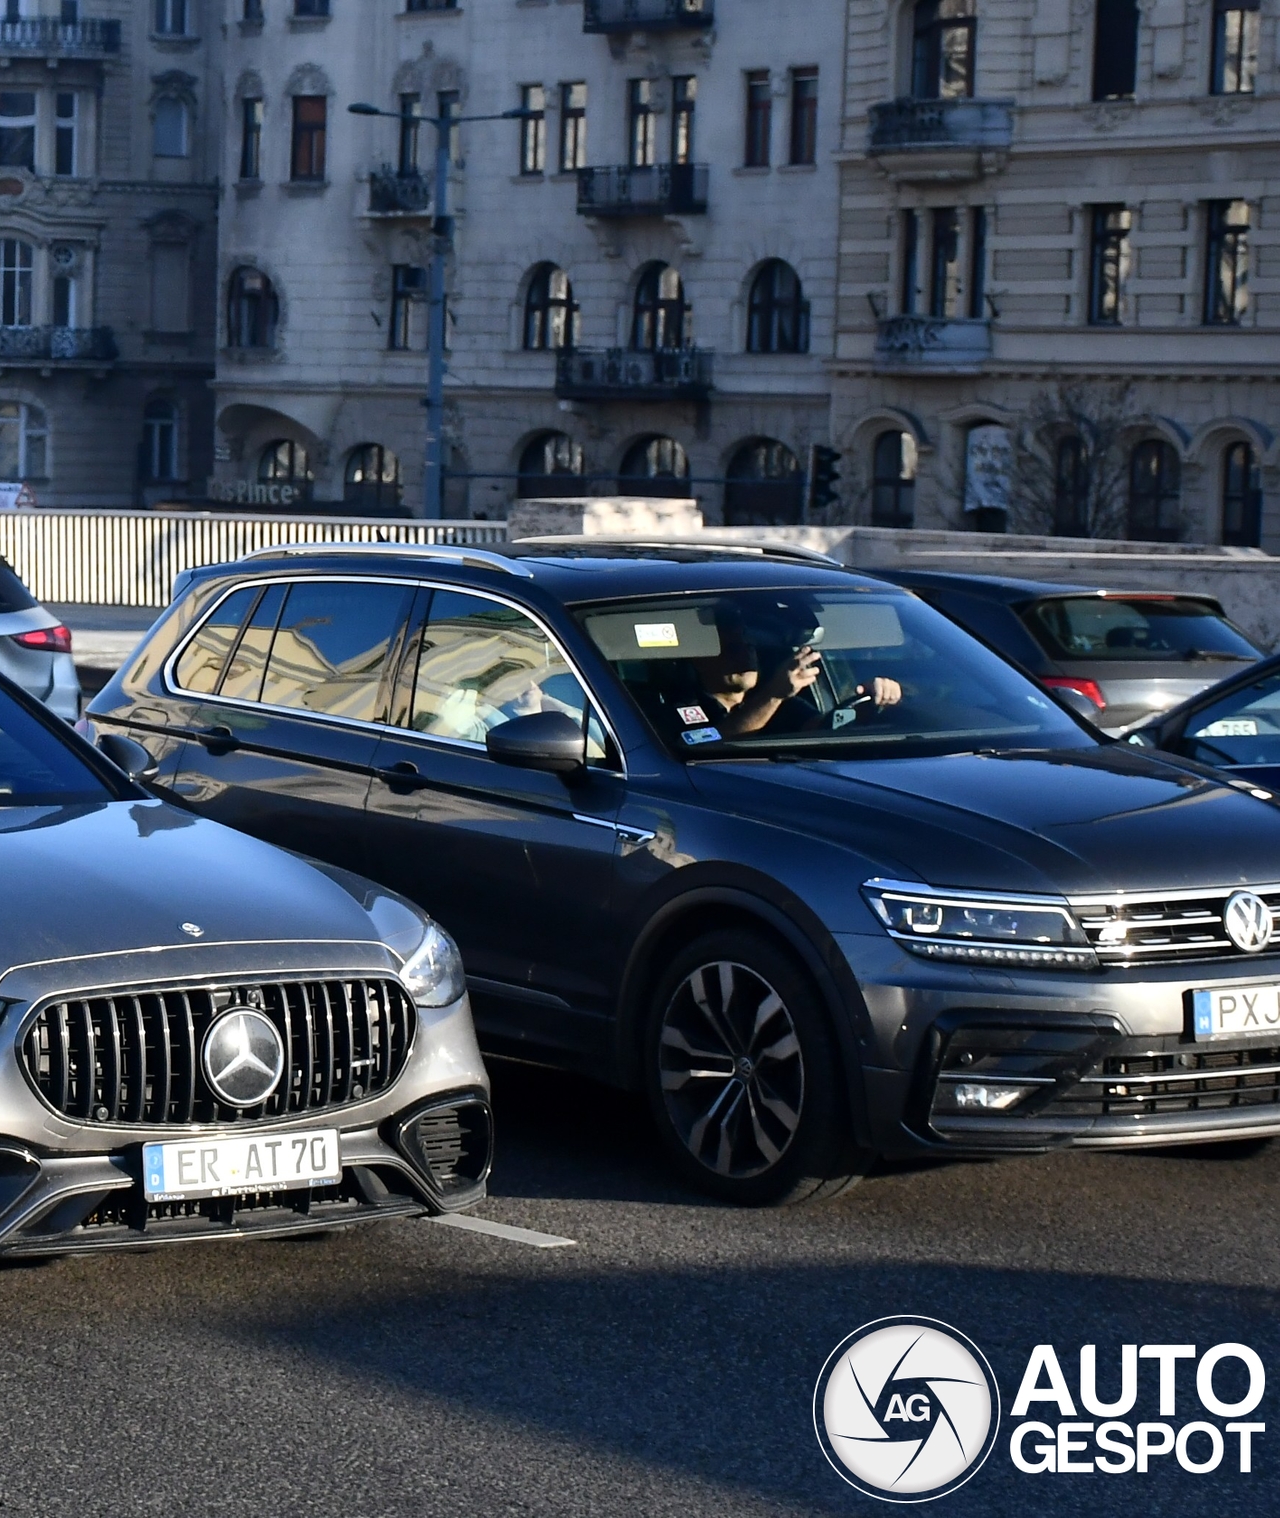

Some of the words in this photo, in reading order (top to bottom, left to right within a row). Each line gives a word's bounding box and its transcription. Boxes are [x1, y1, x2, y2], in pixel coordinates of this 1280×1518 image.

[1218, 991, 1280, 1029] PXJ
[150, 1173, 160, 1186] D
[177, 1148, 221, 1186] ER
[244, 1140, 283, 1180] AT
[291, 1136, 327, 1174] 70
